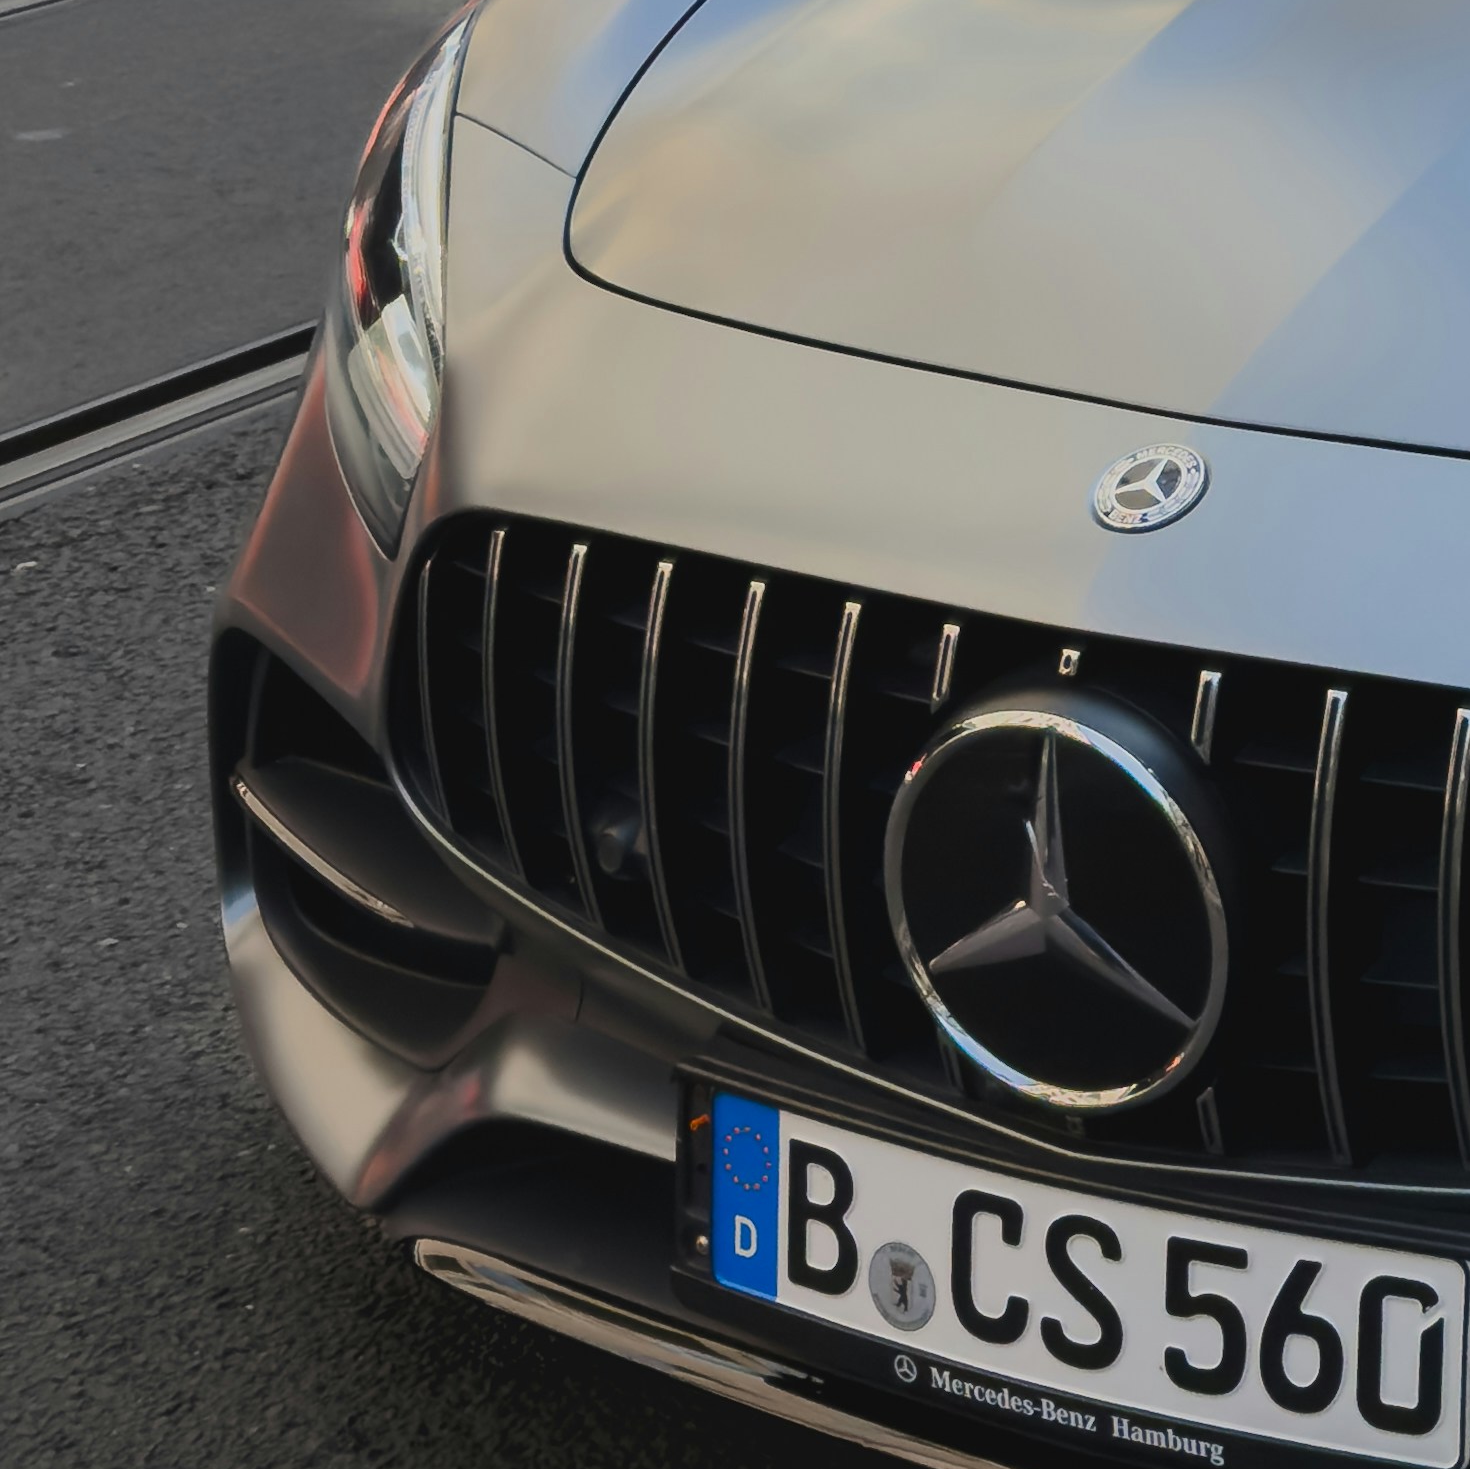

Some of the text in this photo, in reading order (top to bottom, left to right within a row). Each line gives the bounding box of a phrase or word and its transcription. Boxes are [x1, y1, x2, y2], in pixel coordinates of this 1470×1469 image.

[1108, 508, 1143, 524] BENZ
[733, 1214, 759, 1259] D
[787, 1138, 858, 1297] B
[1163, 1234, 1446, 1437] 560
[930, 1365, 1227, 1467] Mercedes-Benz Hamburg
